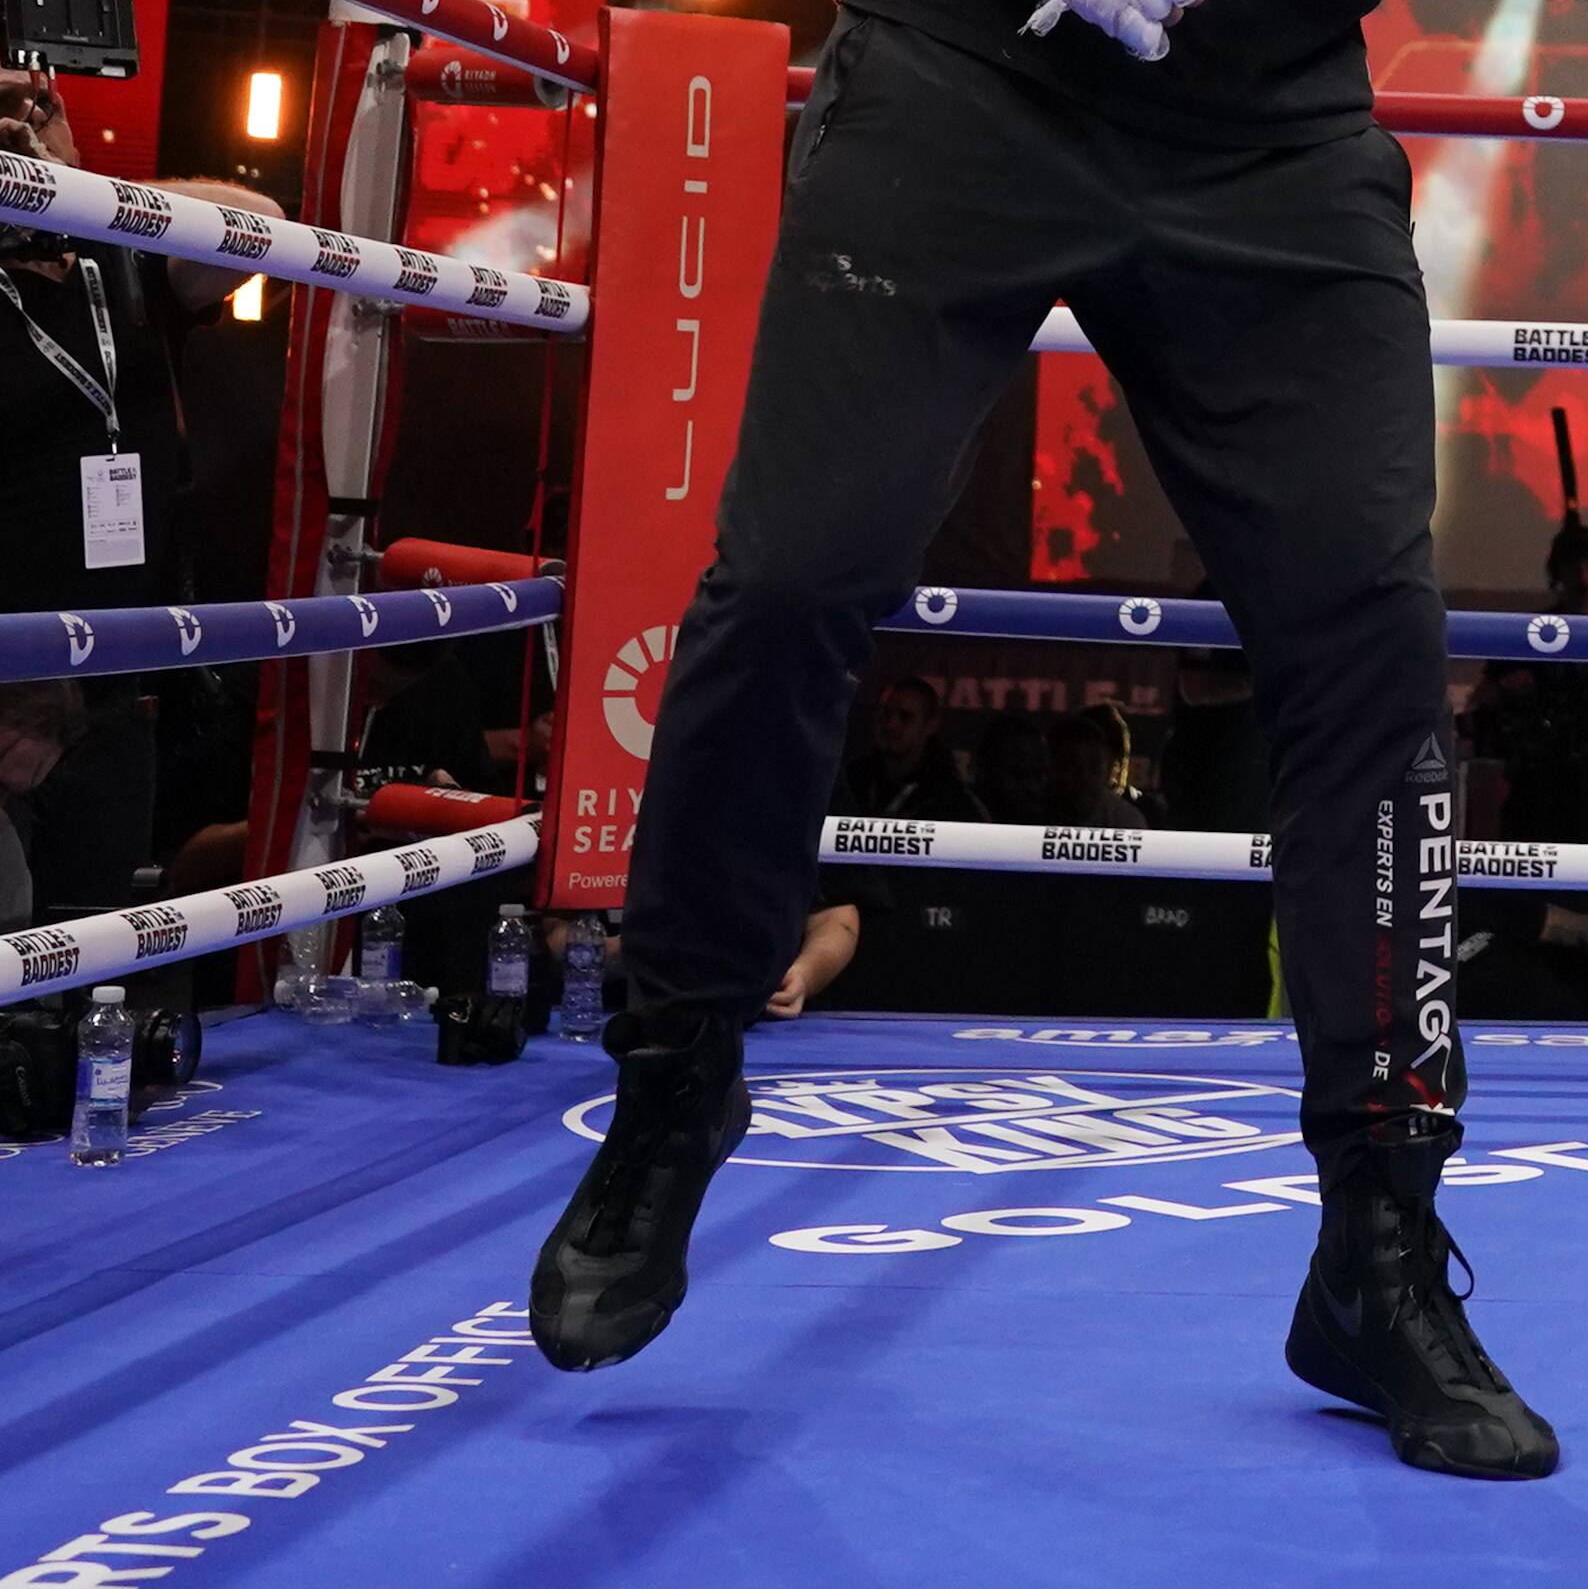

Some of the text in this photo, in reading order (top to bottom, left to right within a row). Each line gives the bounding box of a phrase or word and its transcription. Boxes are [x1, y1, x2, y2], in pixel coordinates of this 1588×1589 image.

[110, 180, 162, 211] BATTLE
[108, 206, 172, 239] BADDEST
[217, 206, 262, 233] BATTLE
[216, 230, 272, 260] BADDEST
[312, 229, 352, 253] BATTLE
[310, 251, 360, 279] BADDEST
[394, 248, 431, 273] BATTLE
[393, 270, 438, 295] BADDEST
[469, 265, 502, 287] BATTLE
[466, 286, 507, 308] BADDEST
[577, 788, 645, 817] RIY
[573, 824, 637, 853] SEA
[836, 819, 918, 834] BATTLE
[1043, 828, 1124, 842] BATTLE
[466, 832, 501, 854] BATTLE
[835, 836, 934, 855] BADDEST
[1042, 842, 1142, 863] BADDEST
[1376, 800, 1393, 893] EXPERTS
[1459, 842, 1539, 857] BATTLE
[395, 849, 432, 872] BATTLE
[471, 850, 506, 875] BADDEST
[1458, 858, 1557, 878] BADDEST
[315, 867, 356, 891] BATTLE
[402, 867, 440, 894] BADDEST
[568, 872, 629, 890] Powere
[225, 885, 271, 910] BATTLE
[322, 885, 366, 915] BADDEST
[121, 907, 173, 931] BATTLE
[235, 904, 282, 936] BADDEST
[1377, 898, 1393, 928] EN
[5, 930, 64, 957] BATTLE
[136, 925, 188, 959] BADDEST
[21, 947, 80, 986] BADDEST
[1373, 1050, 1390, 1081] DE
[745, 1075, 1128, 1138] YPSY
[863, 1107, 1262, 1175] KING
[166, 1420, 415, 1499] BOX
